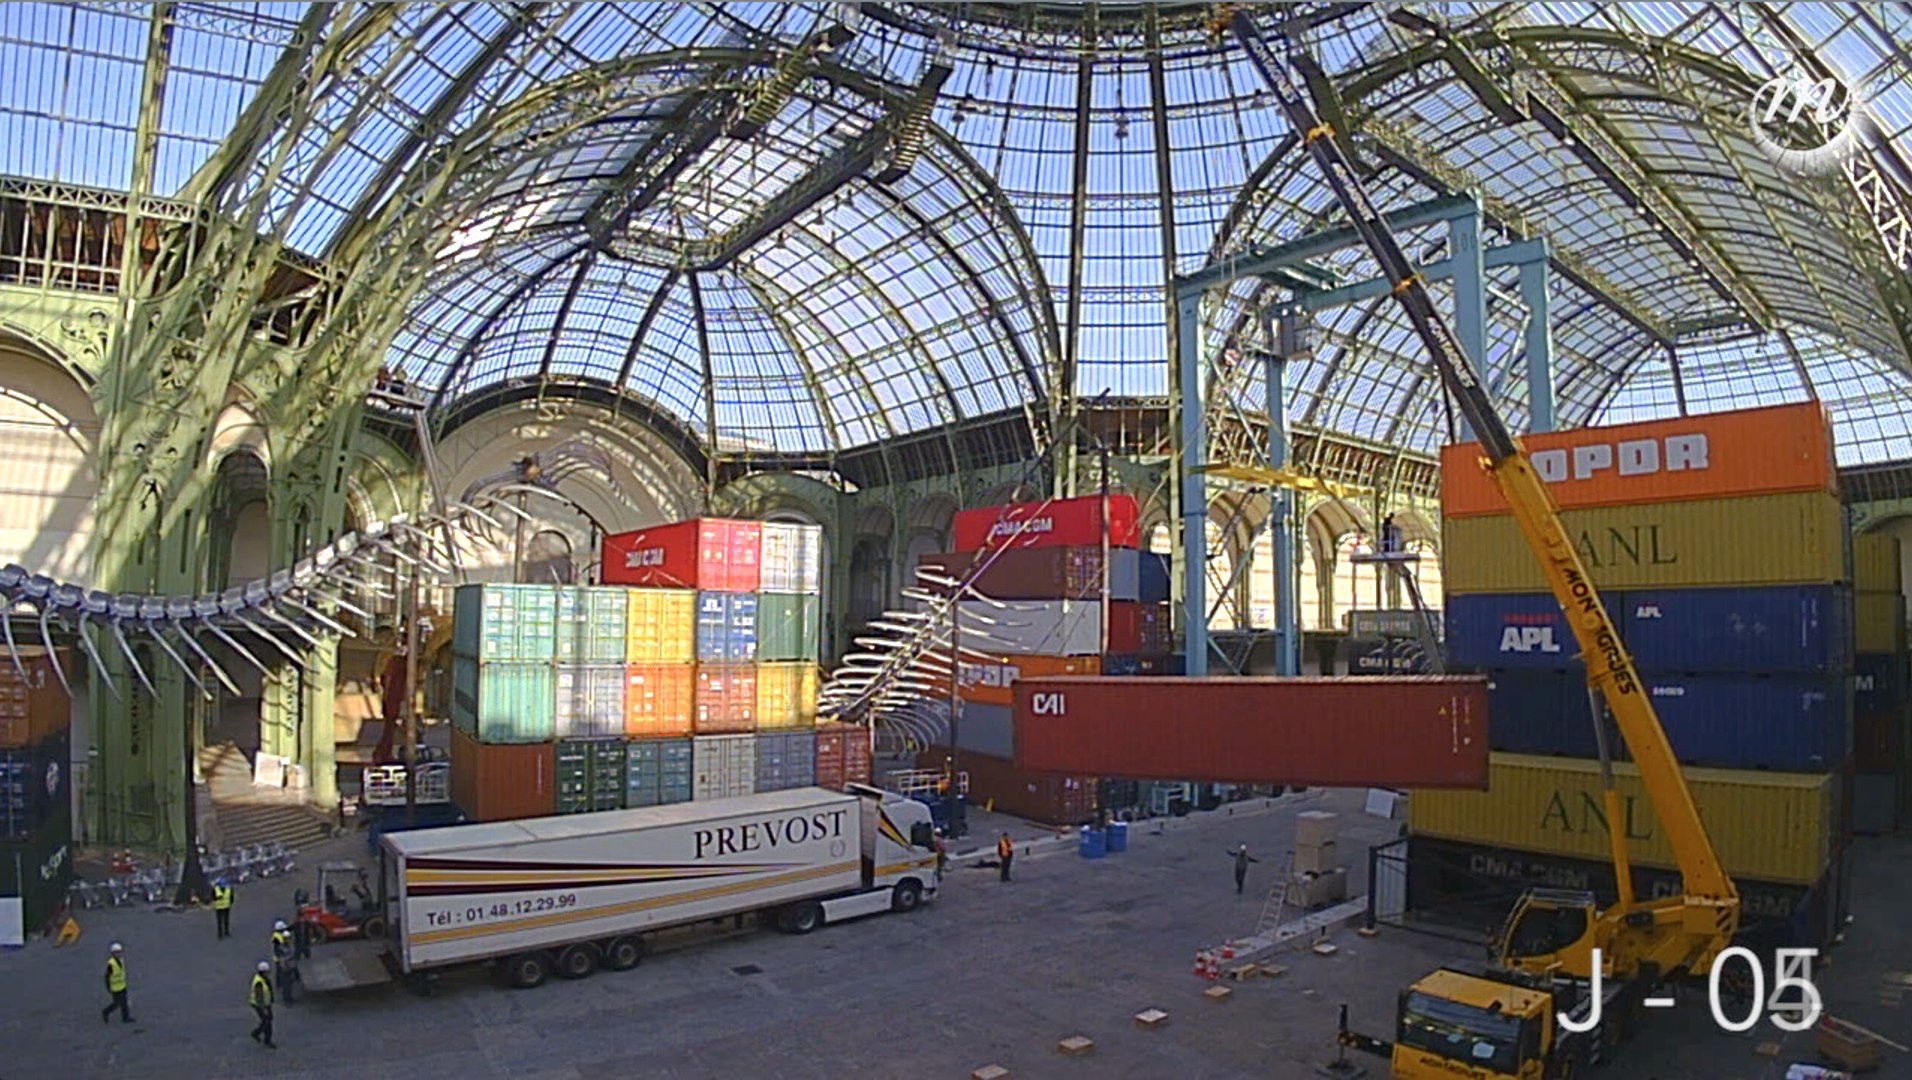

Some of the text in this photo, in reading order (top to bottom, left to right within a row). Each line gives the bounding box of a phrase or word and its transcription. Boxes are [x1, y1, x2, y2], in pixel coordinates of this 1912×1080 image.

[1530, 433, 1709, 484] OPDR
[1576, 524, 1678, 568] ANL
[1636, 606, 1662, 618] APL
[1501, 626, 1561, 652] APL
[1033, 693, 1065, 715] CAI
[1540, 790, 1654, 841] ANL
[693, 808, 848, 860] PREVOST
[427, 911, 452, 926] Tél
